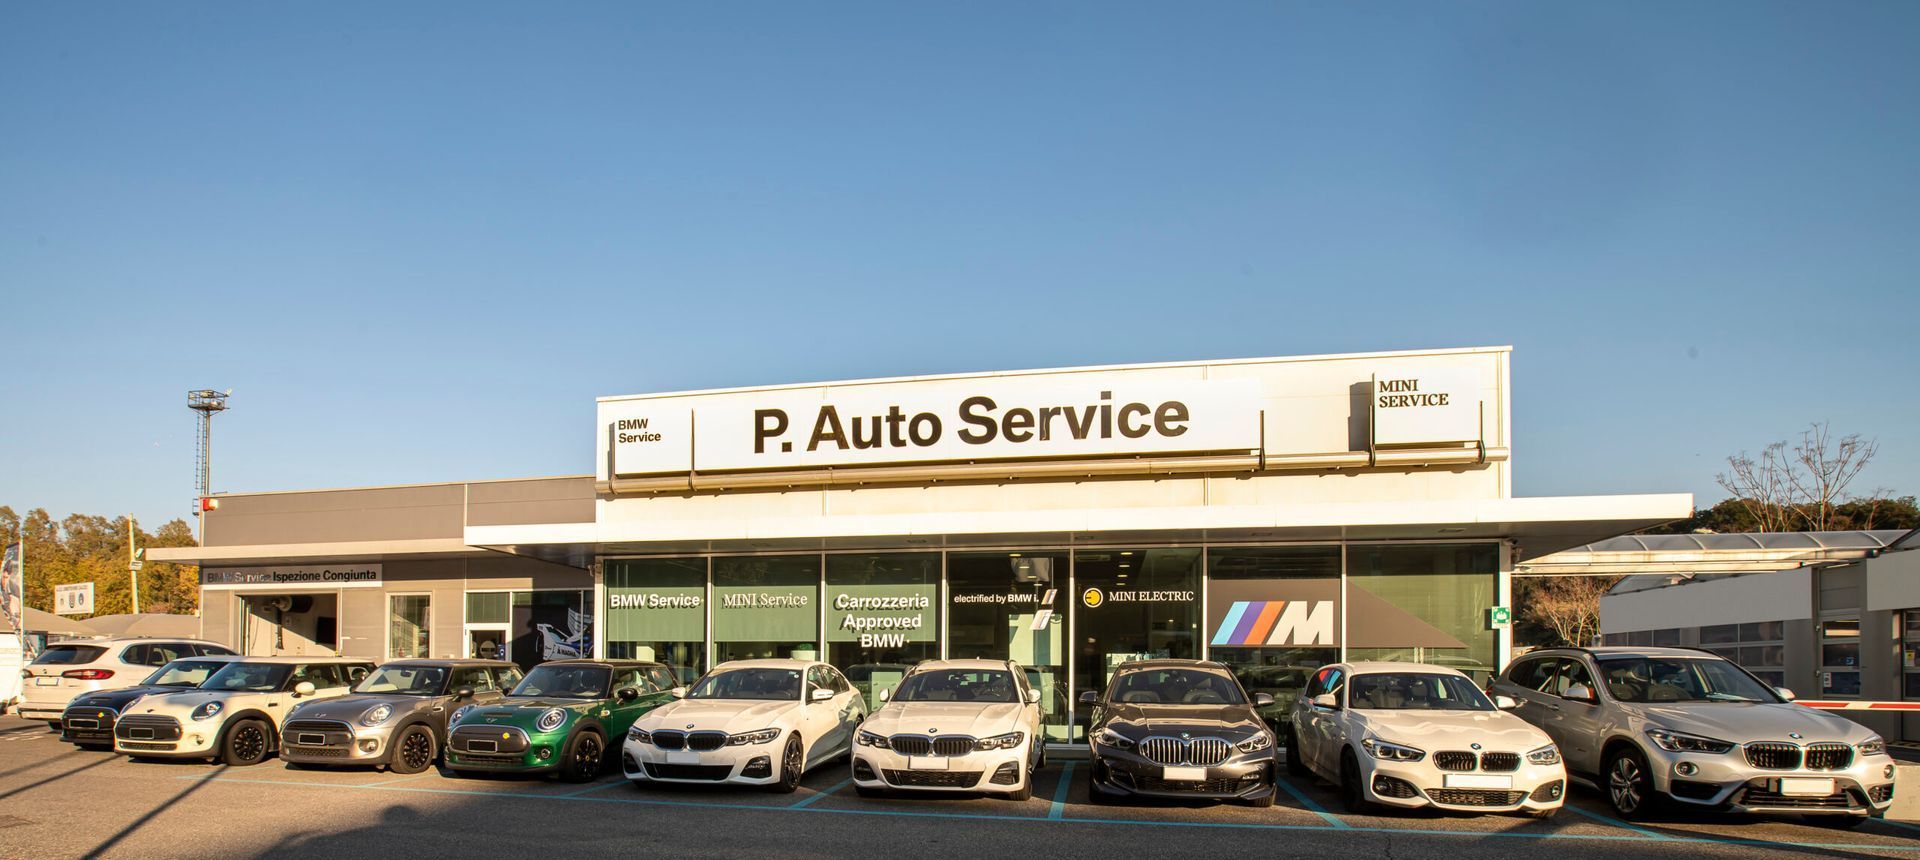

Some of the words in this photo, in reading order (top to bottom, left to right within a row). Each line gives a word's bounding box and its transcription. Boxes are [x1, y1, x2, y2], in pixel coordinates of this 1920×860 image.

[1379, 379, 1419, 393] MINI
[1379, 393, 1449, 408] SERVICE
[618, 418, 649, 430] BMW
[753, 408, 793, 454] P.
[806, 404, 943, 452] Auto
[957, 390, 1190, 445] Service
[618, 431, 661, 443] Service
[273, 570, 321, 583] Ispezione
[323, 569, 377, 583] Congiunta
[610, 594, 647, 607] BMW
[649, 593, 700, 607] Service
[723, 593, 758, 606] MINI
[760, 592, 808, 606] Service
[837, 593, 929, 608] Carrozzeria
[954, 593, 994, 603] electrified
[995, 594, 1006, 604] by
[1007, 593, 1032, 602] BMW
[1109, 591, 1137, 602] MINI
[1138, 590, 1194, 602] ELECTRIC
[843, 613, 922, 629] Approved
[861, 633, 905, 648] BMW
